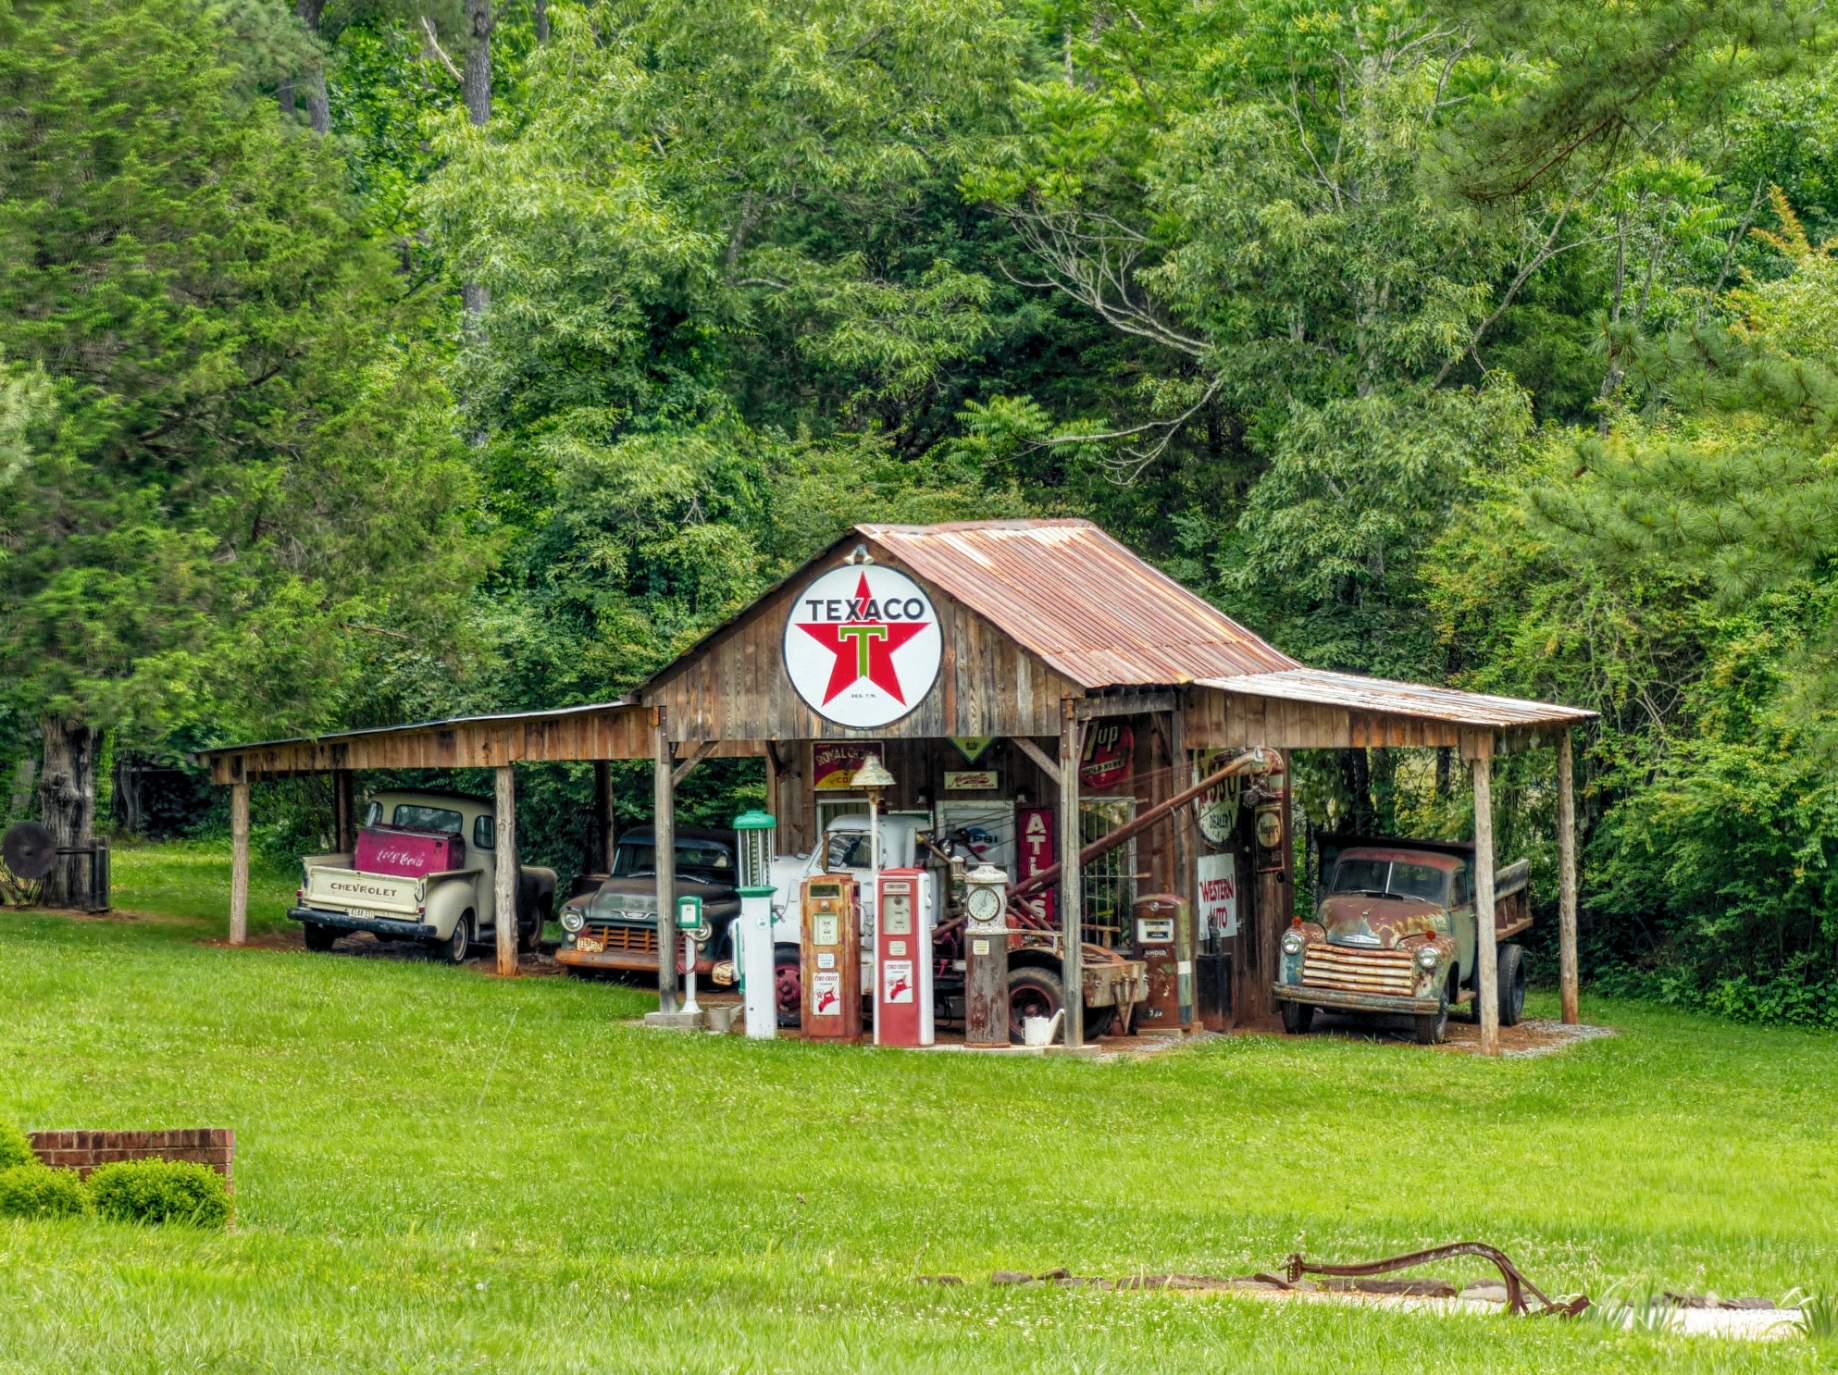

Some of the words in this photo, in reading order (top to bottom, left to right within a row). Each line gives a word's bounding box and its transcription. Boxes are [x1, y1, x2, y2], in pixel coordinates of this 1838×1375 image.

[806, 598, 925, 621] TEXACO
[1025, 813, 1047, 919] ATLS
[330, 882, 397, 897] CHEVROLET
[1200, 876, 1234, 902] WESTERN
